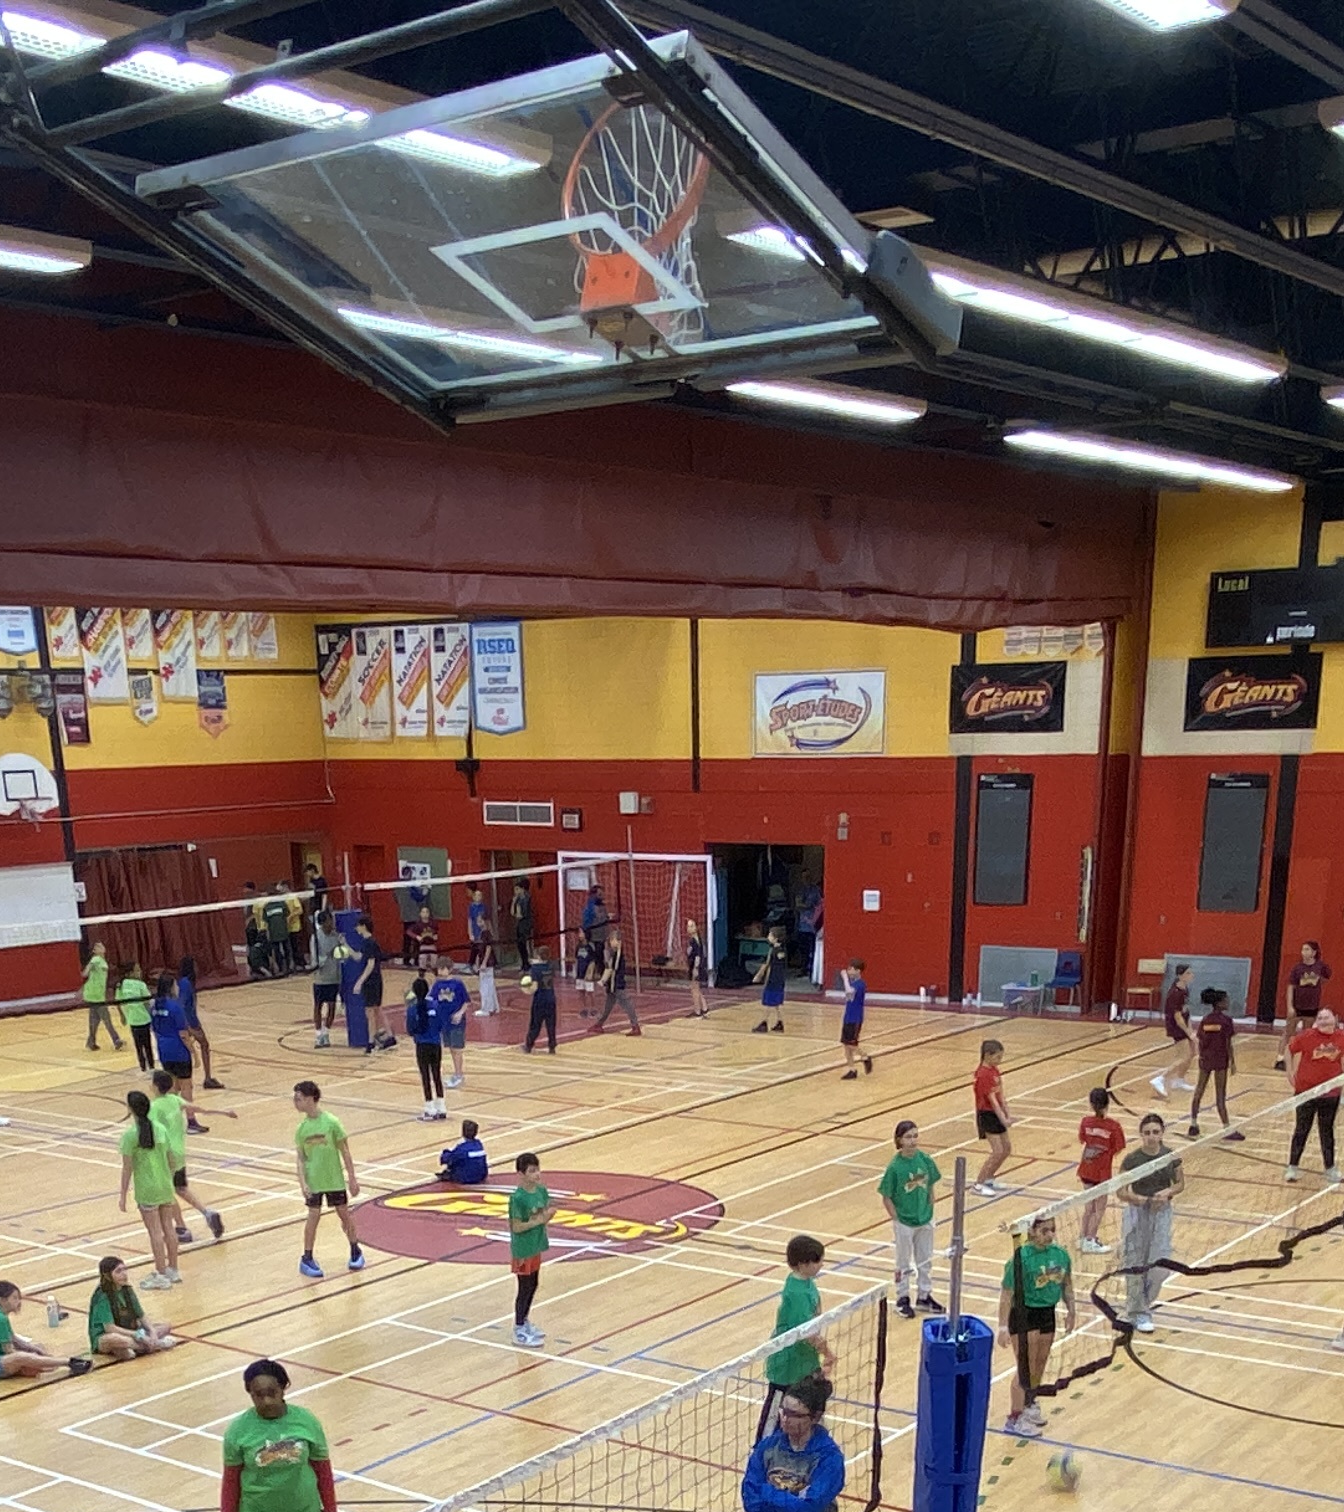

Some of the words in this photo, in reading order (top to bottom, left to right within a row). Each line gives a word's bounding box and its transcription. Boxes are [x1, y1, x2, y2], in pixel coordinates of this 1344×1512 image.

[1218, 576, 1249, 592] Local
[357, 639, 386, 686] SOCCER
[396, 635, 426, 686] NATATION
[434, 634, 467, 686] NATATION
[476, 638, 517, 655] RSEQ
